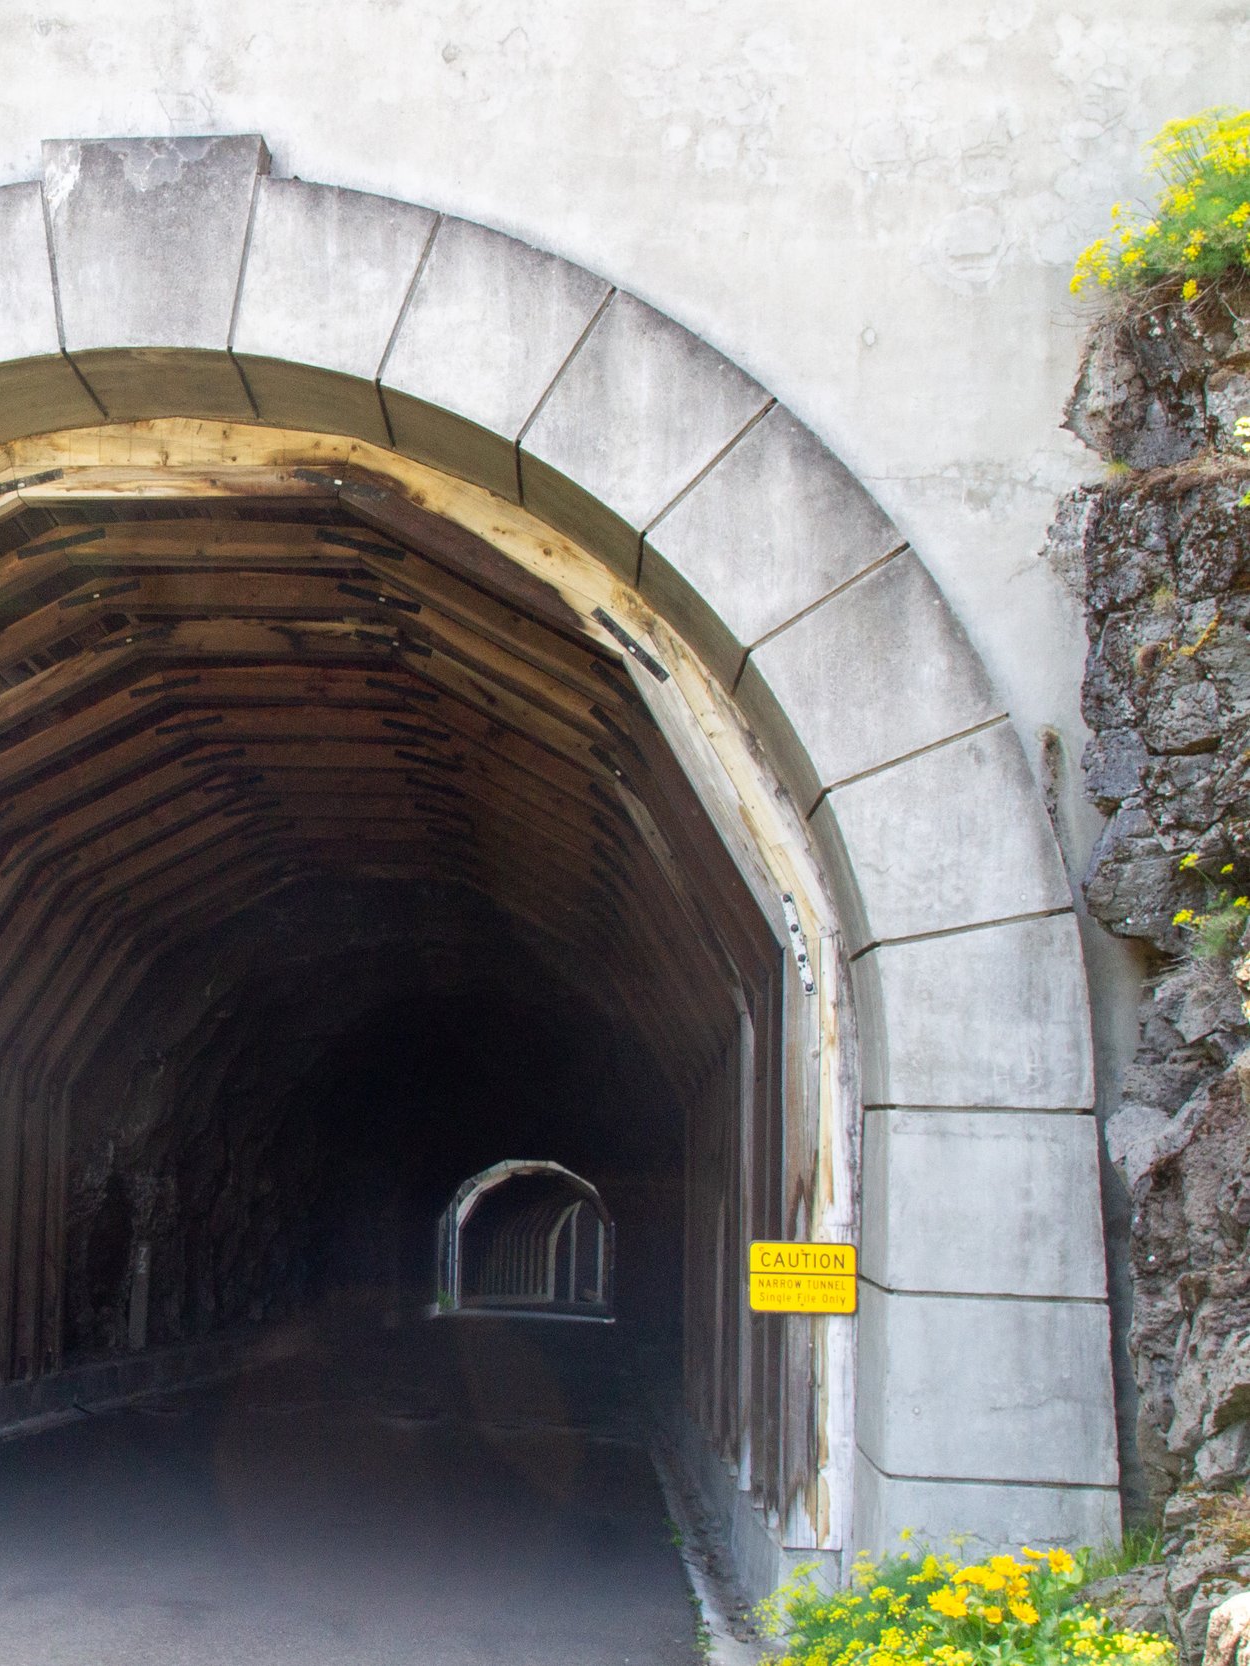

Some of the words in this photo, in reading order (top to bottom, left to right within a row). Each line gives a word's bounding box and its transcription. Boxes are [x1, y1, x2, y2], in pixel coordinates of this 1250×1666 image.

[760, 1252, 845, 1269] CAUTION
[758, 1279, 802, 1289] NARROW
[807, 1280, 846, 1291] TUNNEL
[759, 1292, 792, 1304] Single
[797, 1293, 817, 1303] File
[822, 1294, 846, 1307] Only
